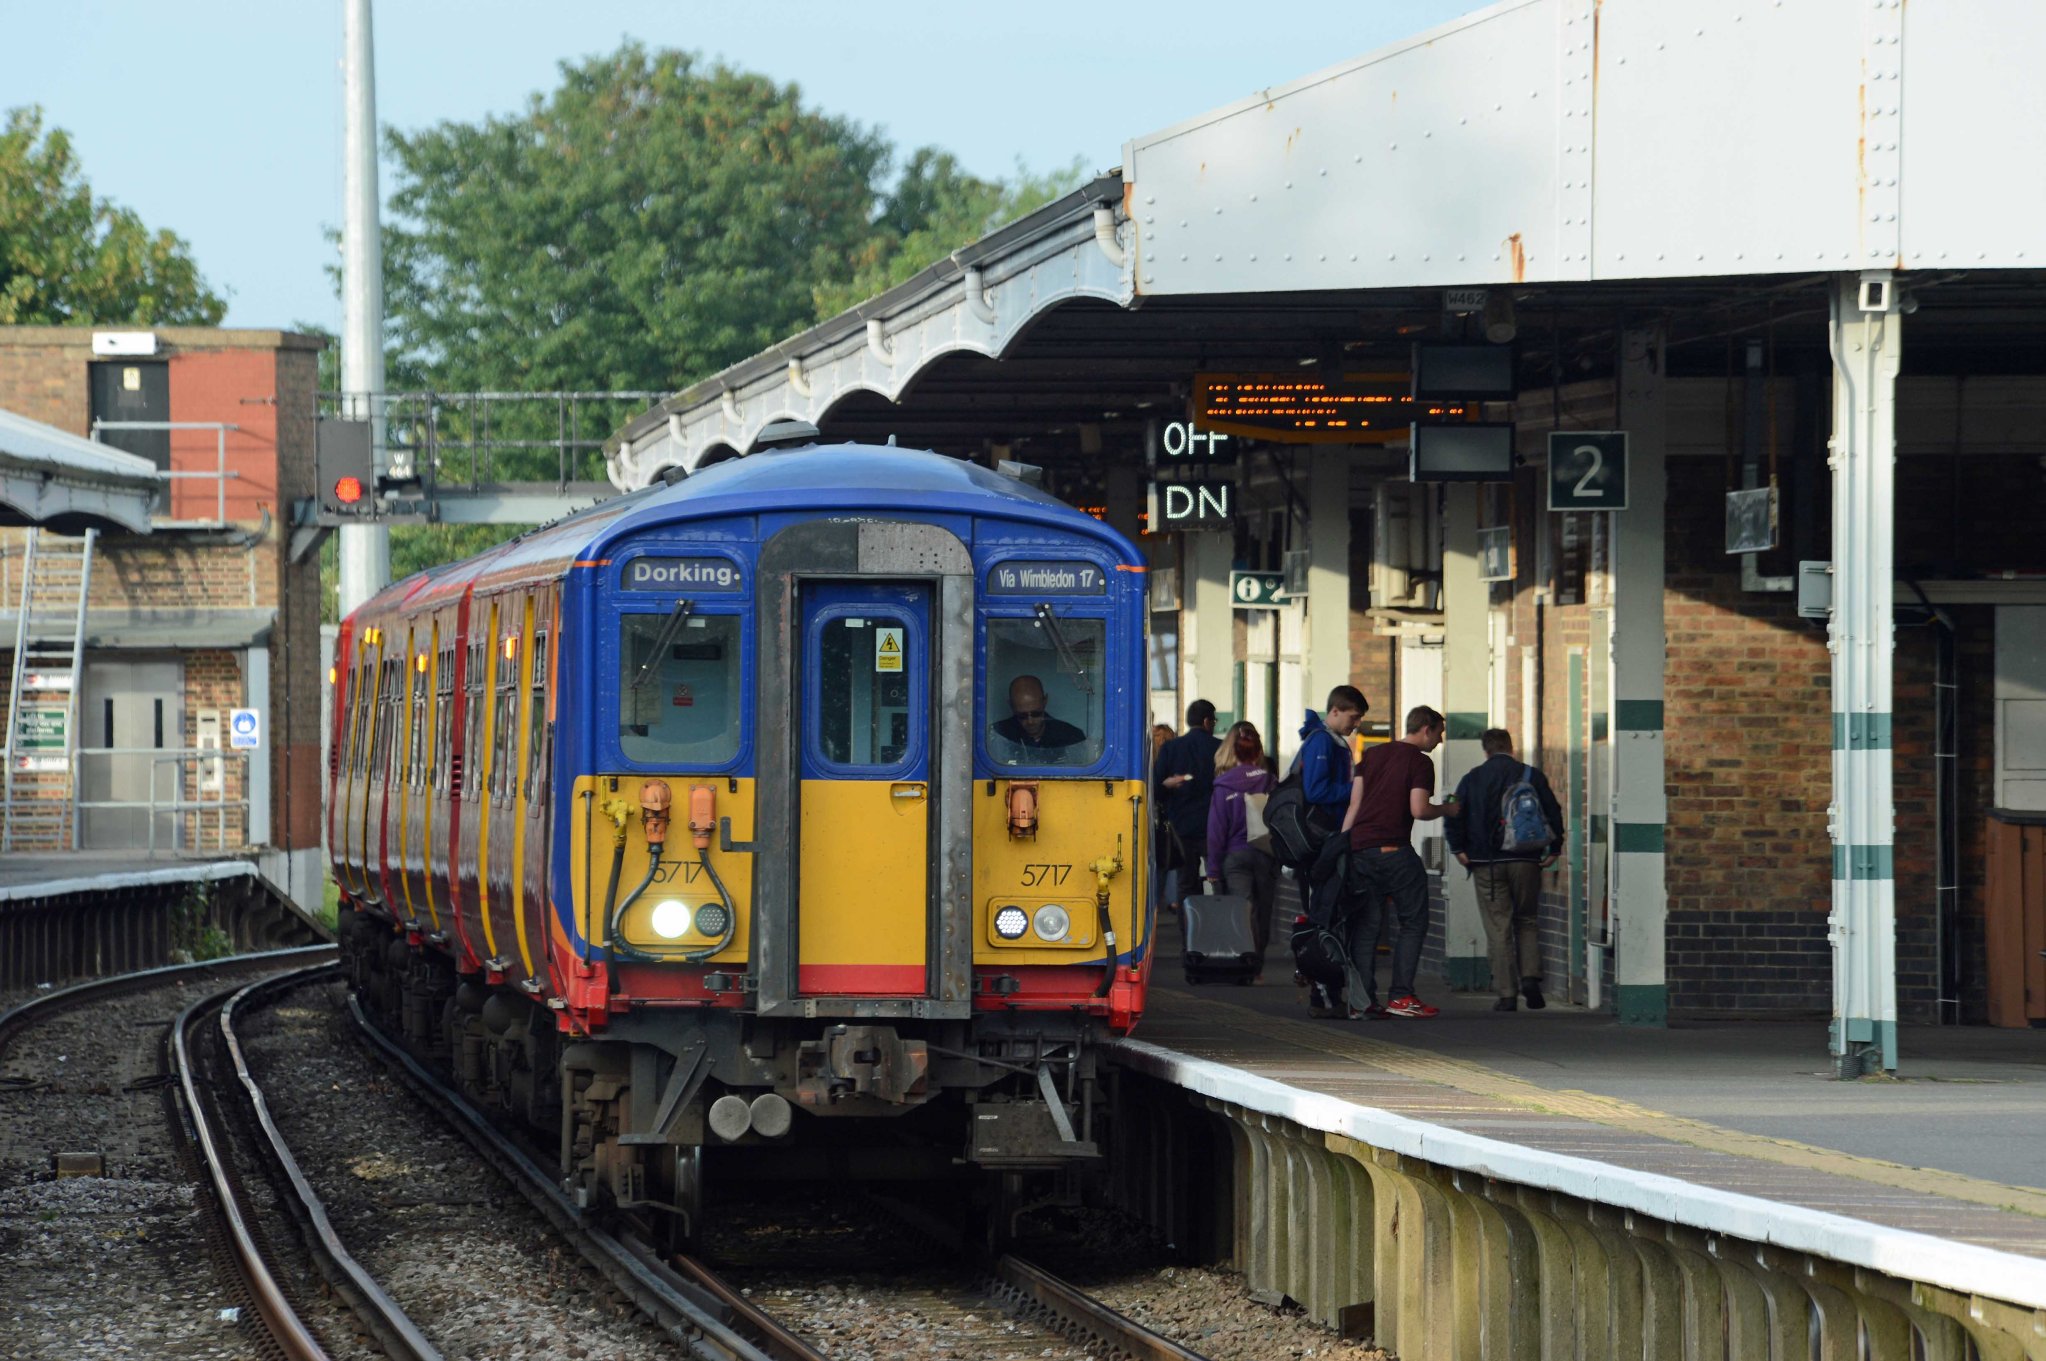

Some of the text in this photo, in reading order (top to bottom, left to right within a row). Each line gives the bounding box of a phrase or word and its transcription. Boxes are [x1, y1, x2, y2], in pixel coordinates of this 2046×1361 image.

[1447, 291, 1486, 305] W462
[393, 452, 404, 465] W
[388, 464, 410, 479] 464
[1572, 445, 1604, 497] 2
[1166, 485, 1228, 519] DN
[634, 563, 732, 586] Dorking
[999, 569, 1095, 588] Via Wimbledon 17
[652, 860, 704, 883] 5717
[1020, 864, 1073, 887] 5717
